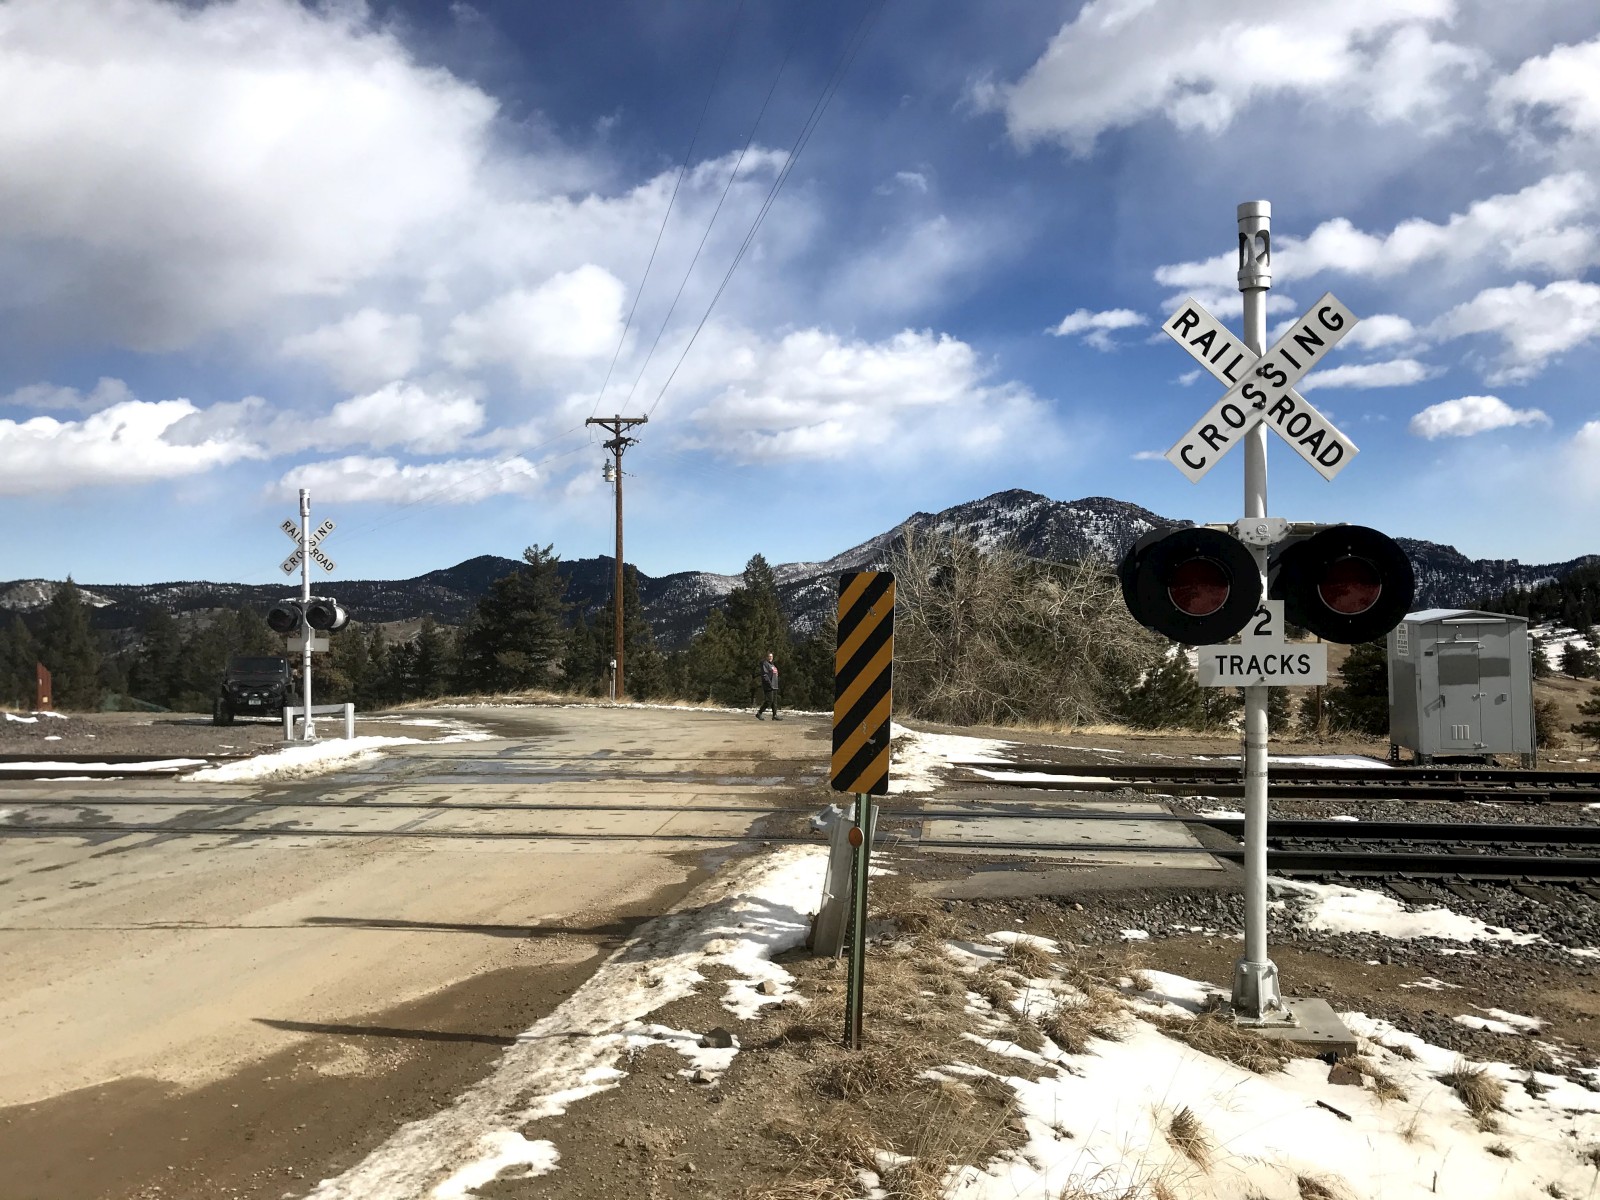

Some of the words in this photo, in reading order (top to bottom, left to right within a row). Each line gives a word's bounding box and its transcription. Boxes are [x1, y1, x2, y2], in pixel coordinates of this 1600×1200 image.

[1172, 308, 1243, 382] RAIL
[1268, 395, 1344, 467] ROAD
[1180, 306, 1344, 470] CROSSING
[282, 521, 303, 544] RAIL
[313, 548, 333, 571] ROAD
[284, 521, 333, 571] CROSING
[1254, 608, 1272, 636] 2
[1215, 654, 1311, 675] TRACKS
